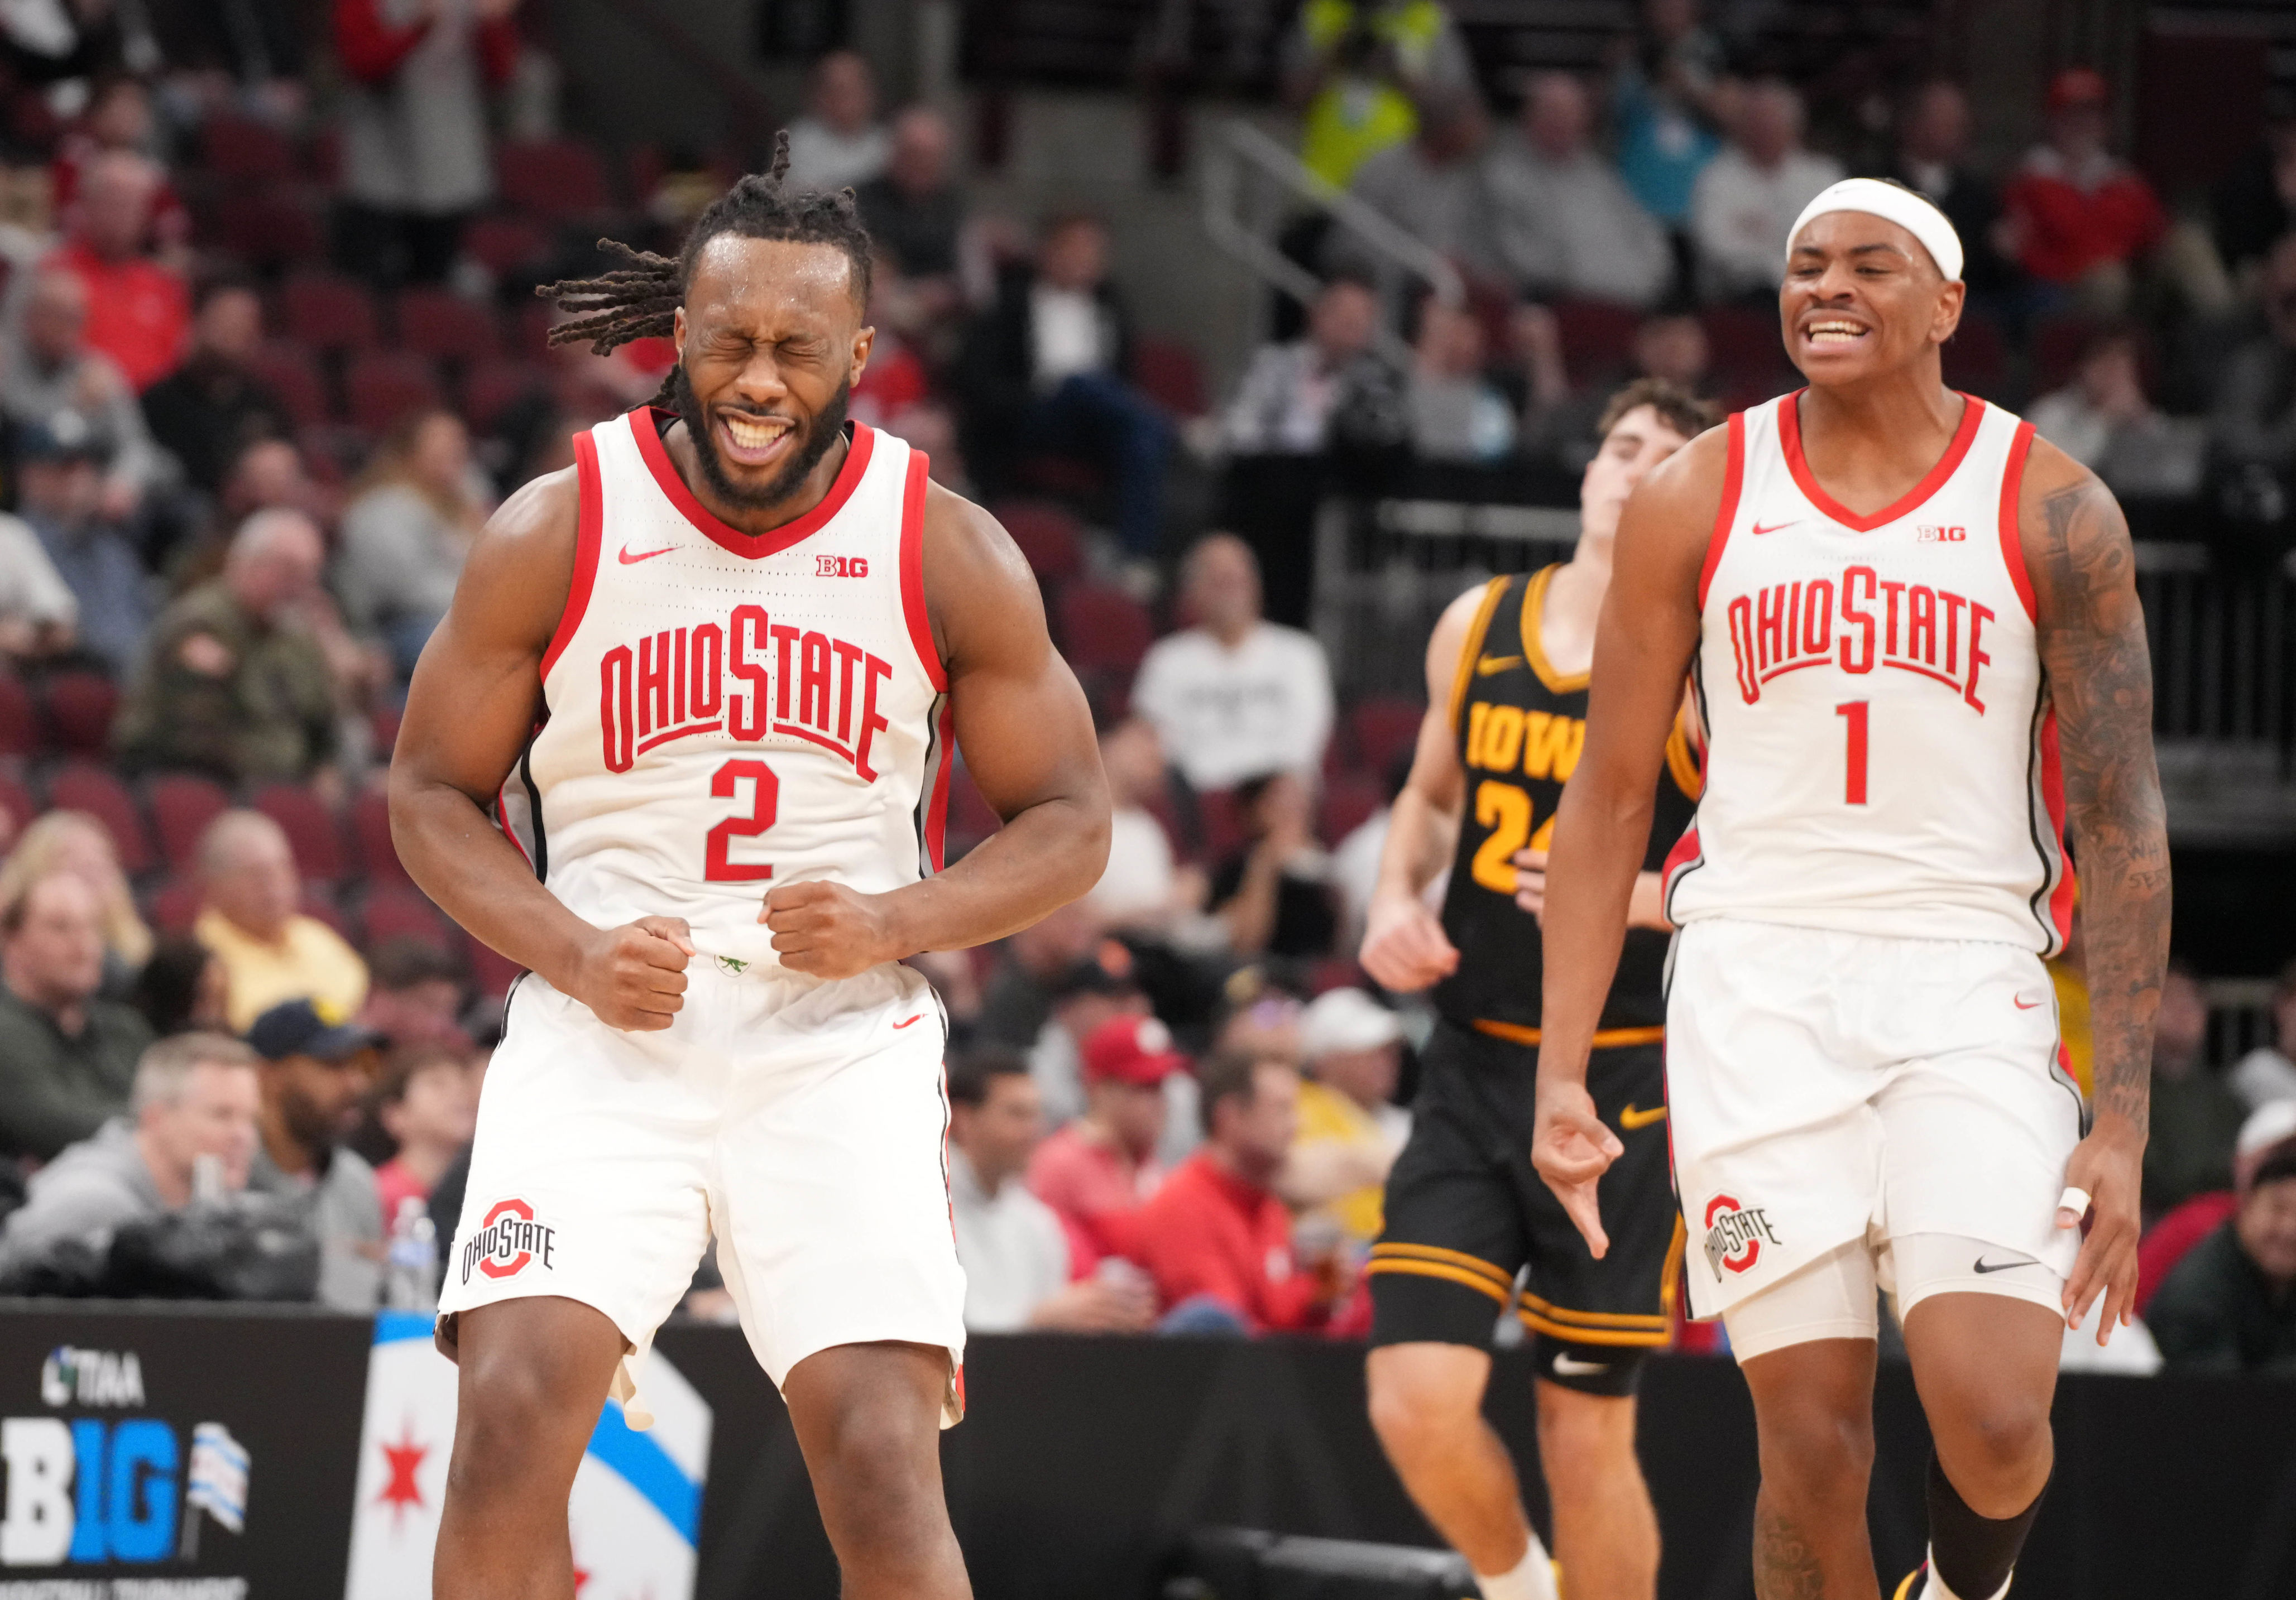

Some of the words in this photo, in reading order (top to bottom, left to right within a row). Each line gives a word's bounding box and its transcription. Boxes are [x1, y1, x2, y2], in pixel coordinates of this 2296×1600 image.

[1465, 701, 1586, 782] IOW
[1835, 700, 1869, 806] 1
[703, 758, 780, 882] 2
